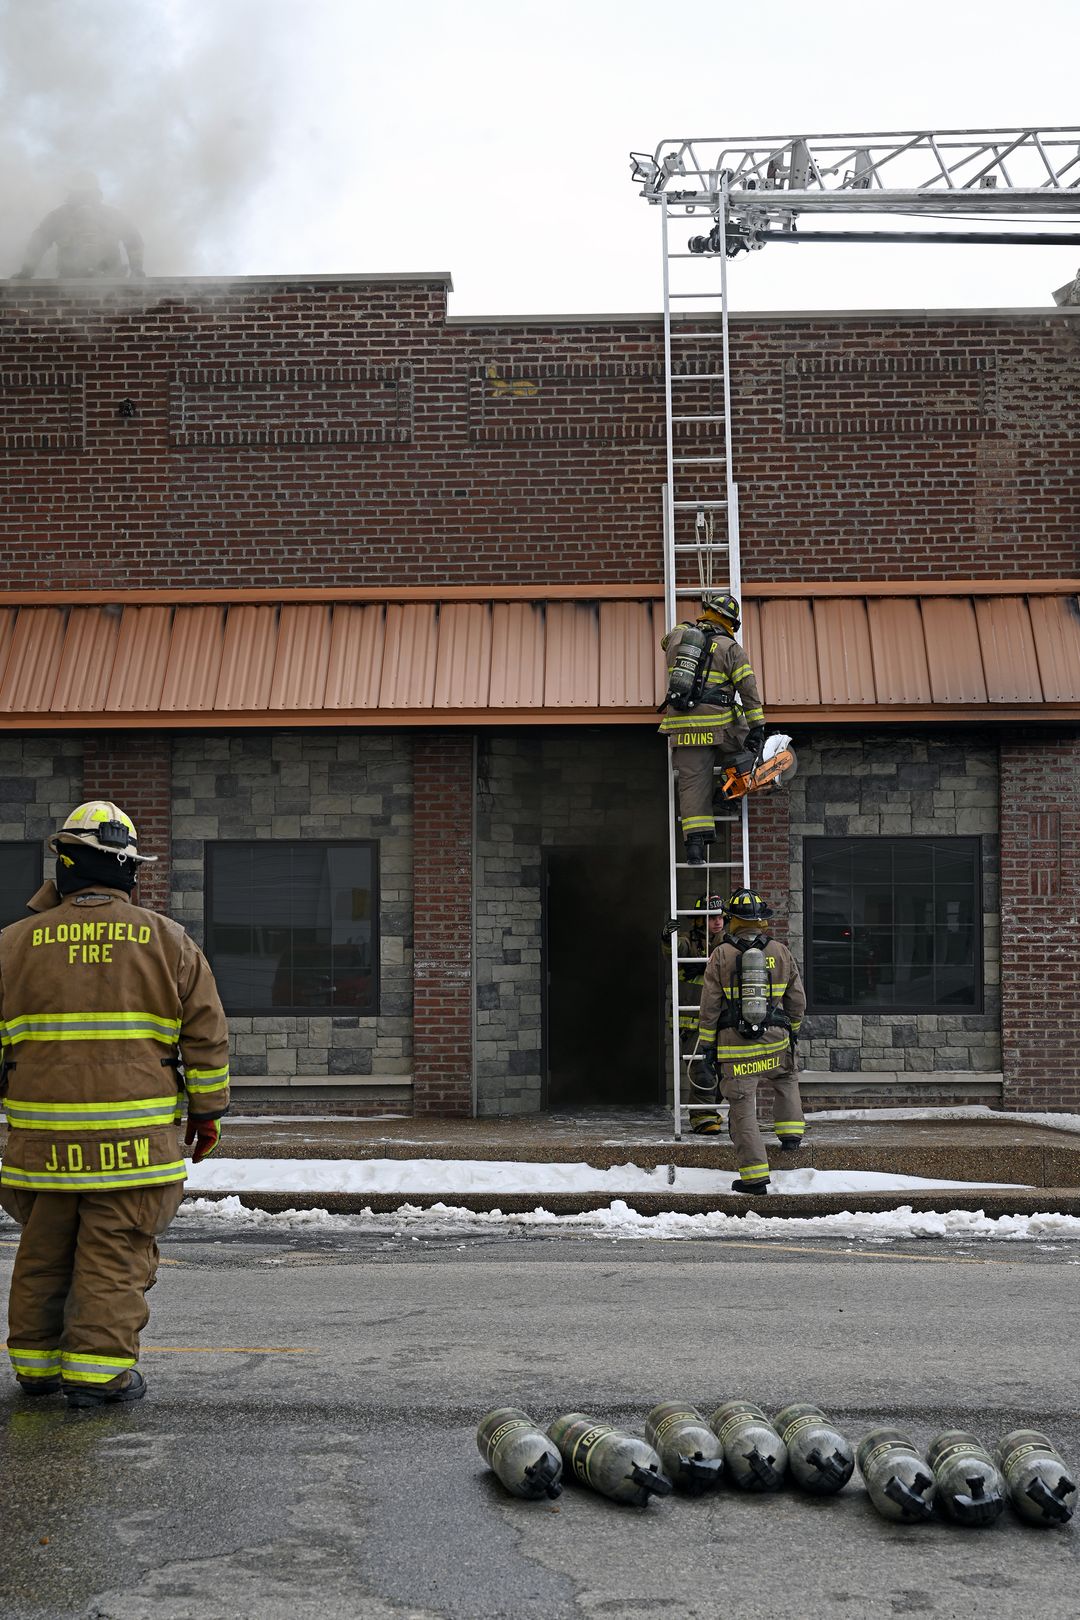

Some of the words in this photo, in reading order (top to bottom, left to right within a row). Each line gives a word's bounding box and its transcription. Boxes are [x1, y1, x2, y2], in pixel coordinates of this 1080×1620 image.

[677, 732, 714, 745] LOVINS
[32, 922, 151, 946] BLOOMFIELD
[68, 943, 113, 964] FIRE
[733, 1056, 781, 1076] MCCONNELL
[45, 1144, 91, 1171] J.D.
[99, 1137, 149, 1170] DEW
